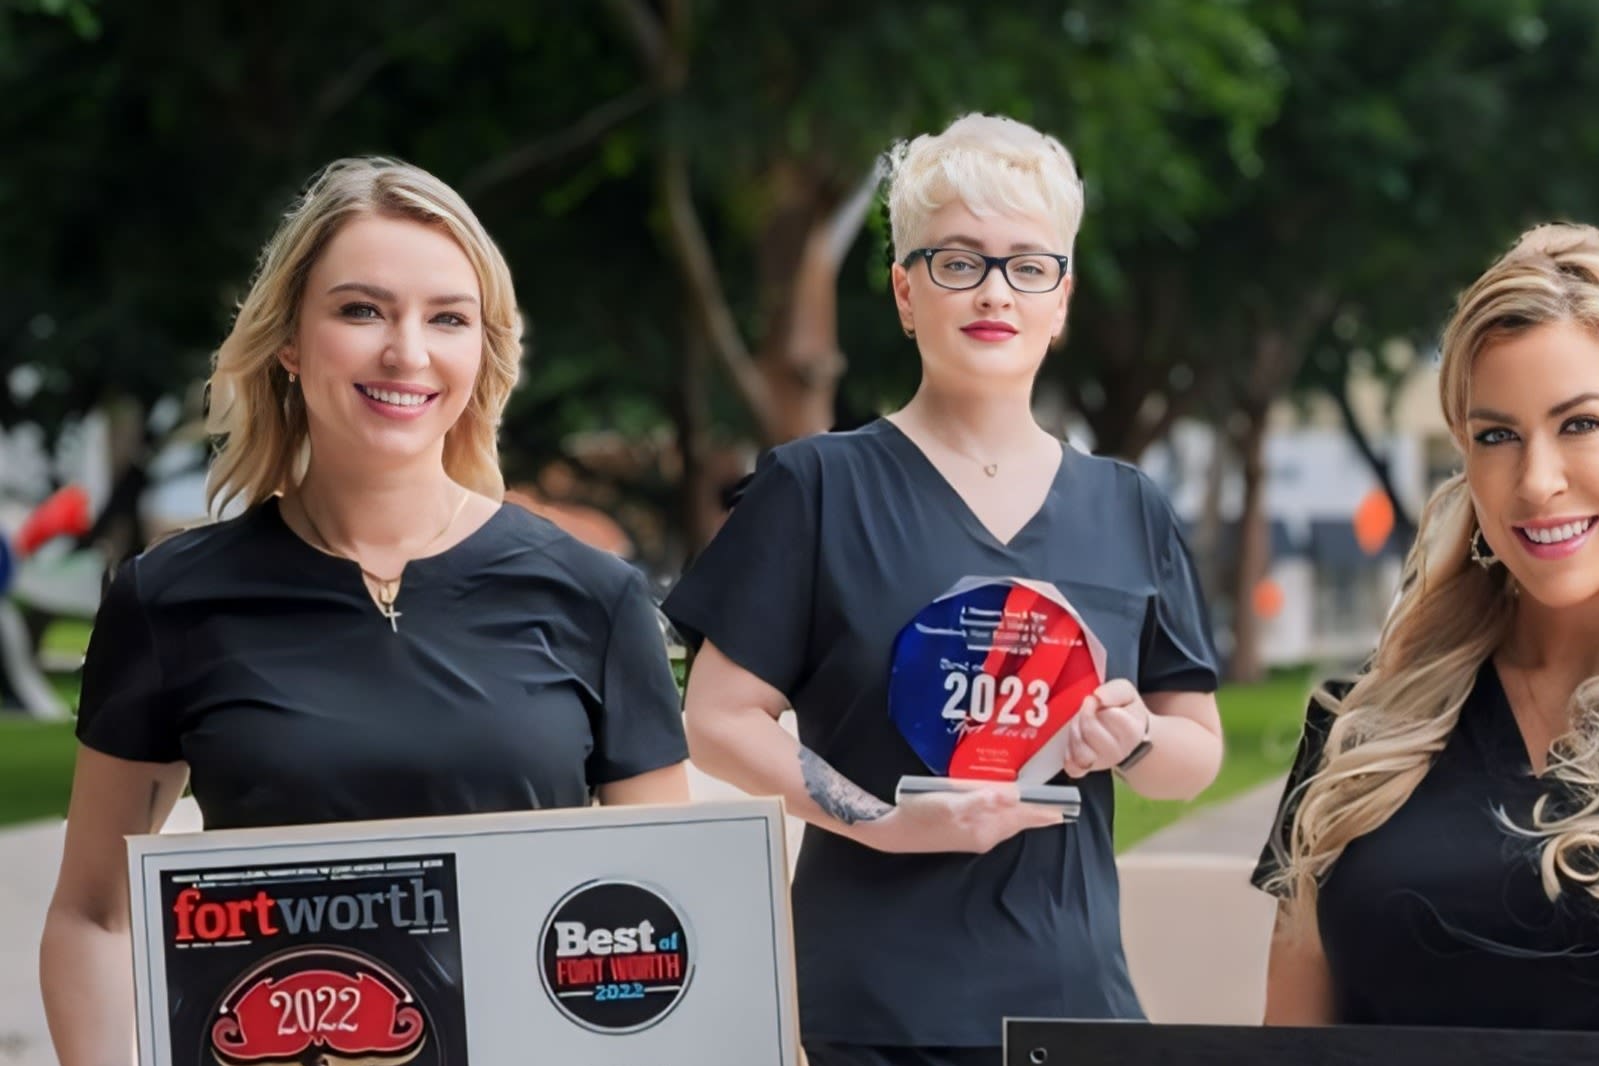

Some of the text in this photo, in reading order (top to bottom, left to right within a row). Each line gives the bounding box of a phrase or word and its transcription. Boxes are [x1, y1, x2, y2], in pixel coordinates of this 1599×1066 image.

[941, 671, 1050, 728] 2023
[554, 919, 656, 957] Best
[269, 986, 361, 1036] 2022
[595, 982, 645, 1001] 2022
